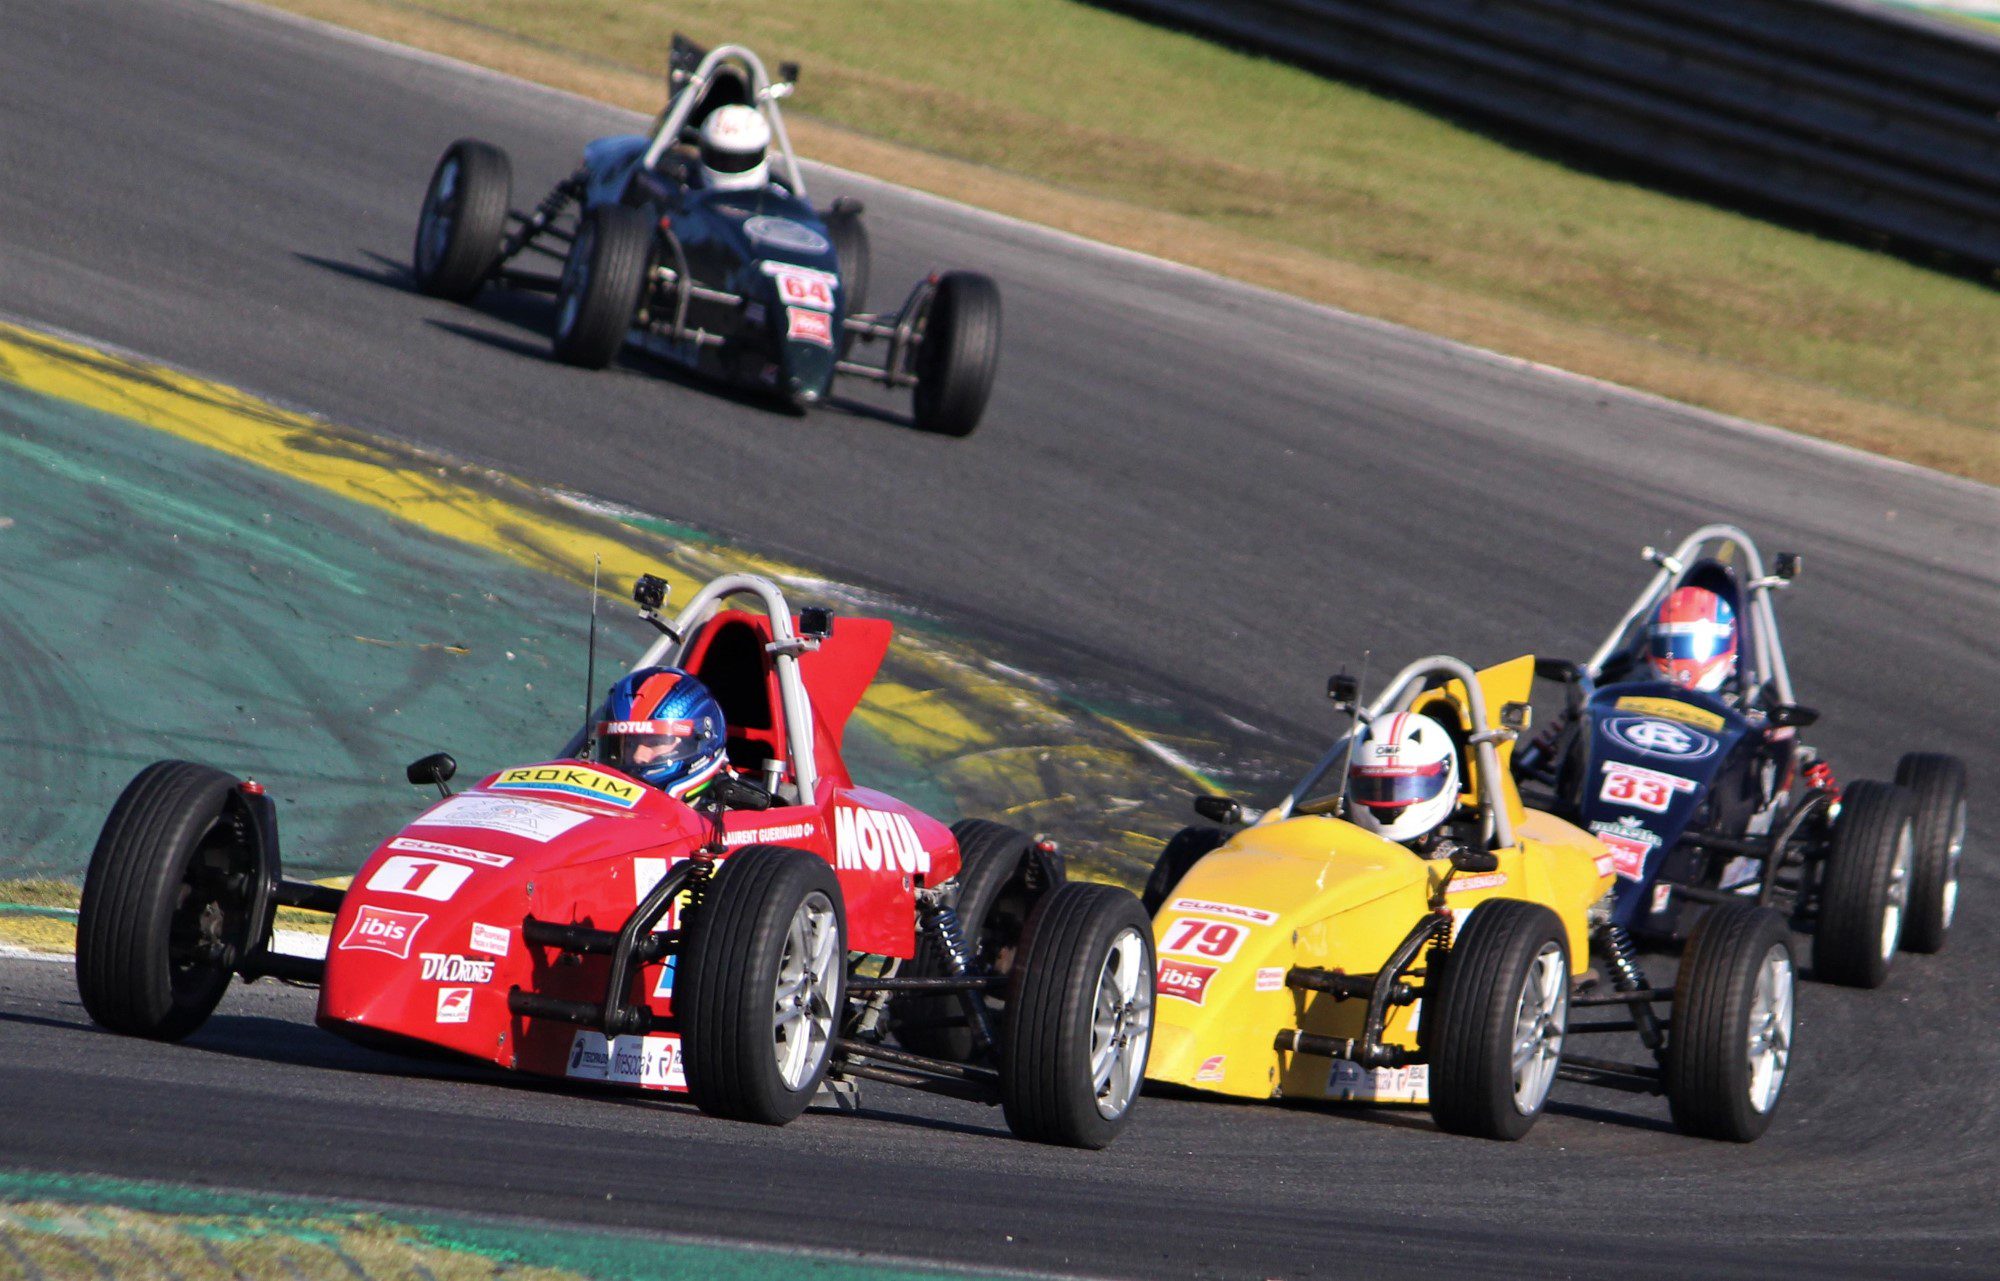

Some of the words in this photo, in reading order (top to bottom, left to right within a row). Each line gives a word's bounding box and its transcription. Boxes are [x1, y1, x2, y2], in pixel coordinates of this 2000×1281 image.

[786, 278, 827, 303] 64
[607, 721, 654, 734] MOTUL
[508, 769, 633, 798] ROKIM
[1608, 774, 1667, 806] 33
[721, 829, 758, 846] LAURENT
[758, 824, 803, 843] GUERINAUD
[834, 805, 931, 874] MOTUL
[402, 862, 440, 892] 1
[359, 917, 407, 940] ibis
[1169, 920, 1240, 957] 79
[1160, 968, 1204, 989] ibis
